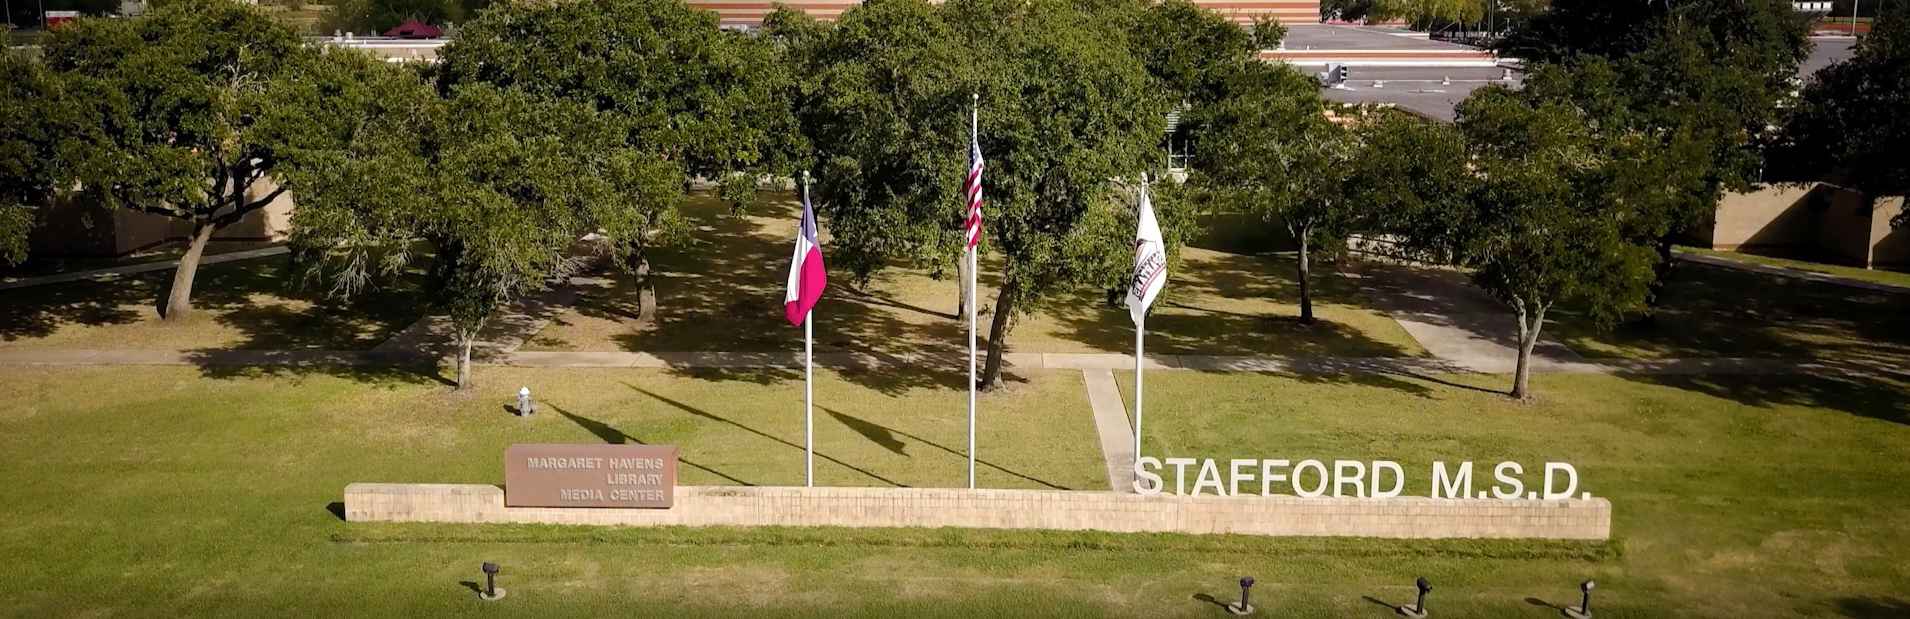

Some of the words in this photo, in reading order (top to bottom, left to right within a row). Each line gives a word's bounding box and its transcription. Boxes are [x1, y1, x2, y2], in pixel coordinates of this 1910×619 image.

[527, 457, 603, 470] MARGARET
[609, 457, 664, 470] HAVENS
[607, 473, 663, 486] LIBRARY
[1132, 456, 1405, 498] STAFFORD
[1432, 461, 1591, 500] M.S.D.
[560, 489, 604, 501] MEDIA
[610, 489, 664, 501] CENTER
